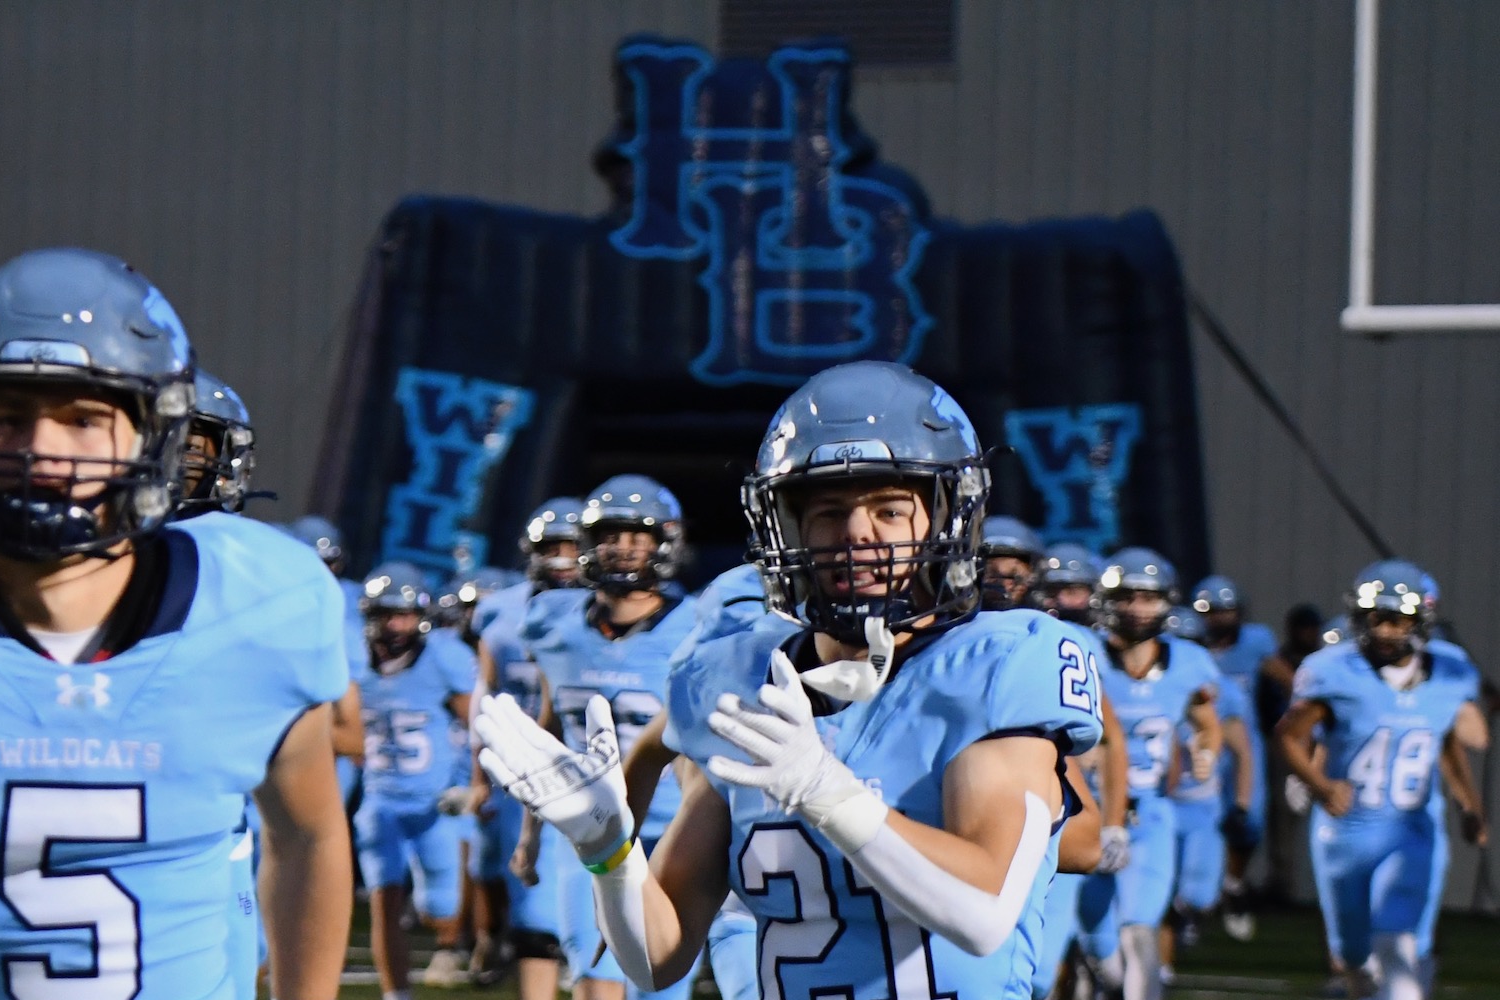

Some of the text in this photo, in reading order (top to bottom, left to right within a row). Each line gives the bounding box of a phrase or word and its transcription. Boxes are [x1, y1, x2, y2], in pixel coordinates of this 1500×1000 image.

[380, 365, 538, 578] WIL
[1003, 402, 1141, 552] WI
[1058, 636, 1104, 728] 21
[1348, 726, 1438, 812] 48
